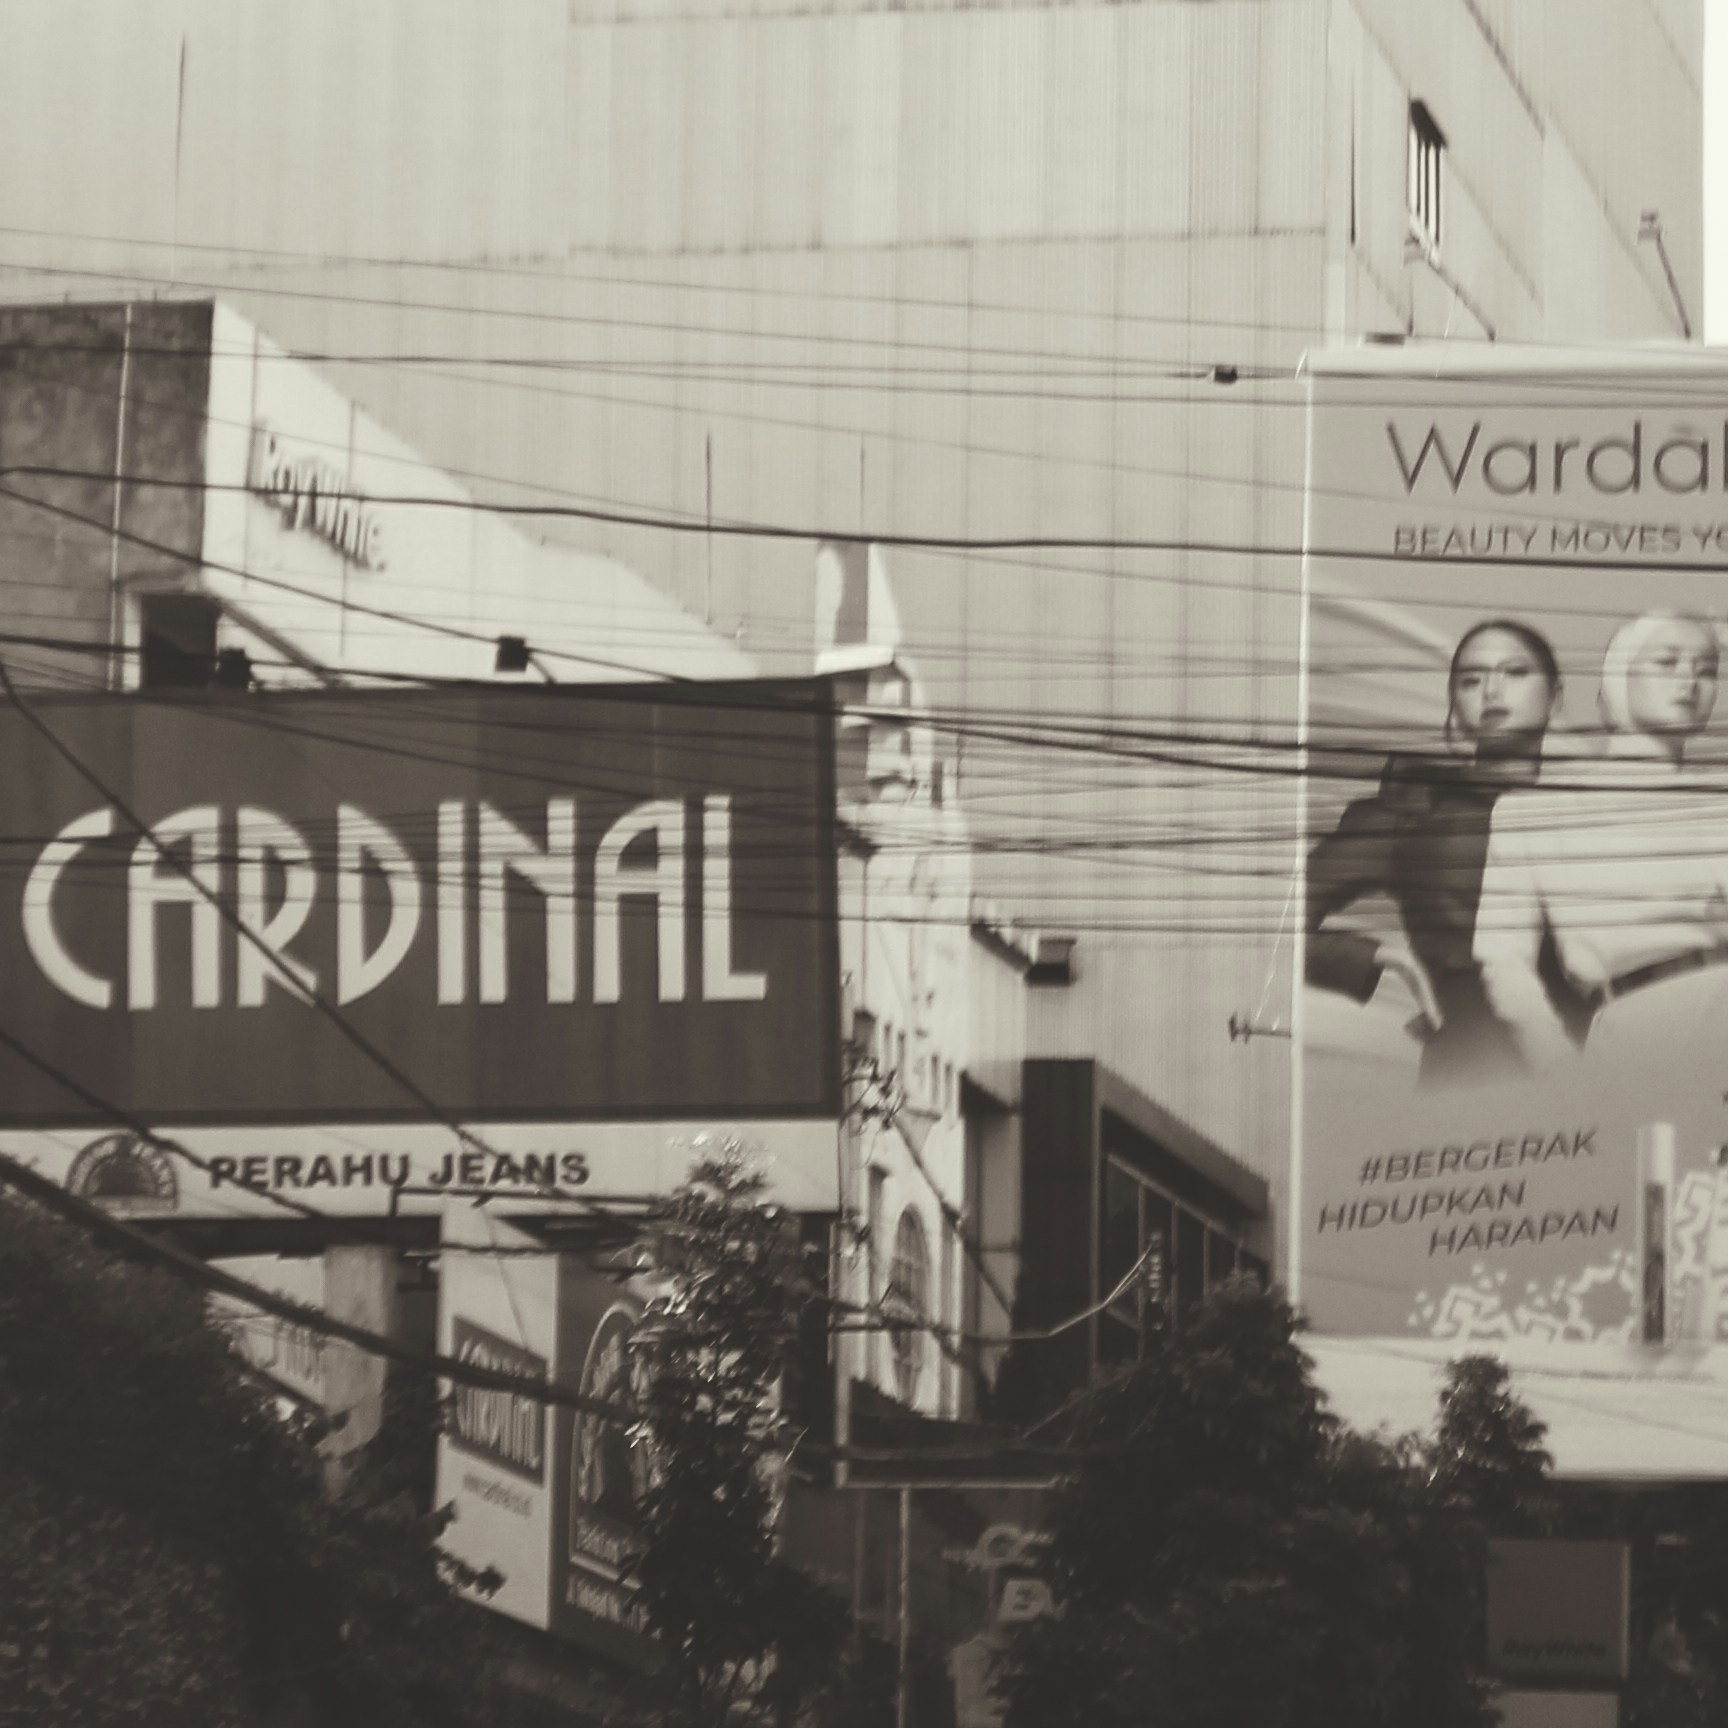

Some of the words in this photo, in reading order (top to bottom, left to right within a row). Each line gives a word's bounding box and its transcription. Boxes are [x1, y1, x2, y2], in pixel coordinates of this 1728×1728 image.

[1386, 418, 1728, 495] Warda
[1394, 524, 1537, 554] BEAUTY
[1550, 524, 1681, 554] MOVES
[22, 794, 767, 1010] CARDINAL
[208, 1153, 410, 1189] PERAHU
[428, 1151, 591, 1187] JEANS
[1359, 1126, 1598, 1187] #BERGERAK
[1317, 1178, 1526, 1234] HIDUPKAN
[1428, 1203, 1621, 1257] HARAPAN
